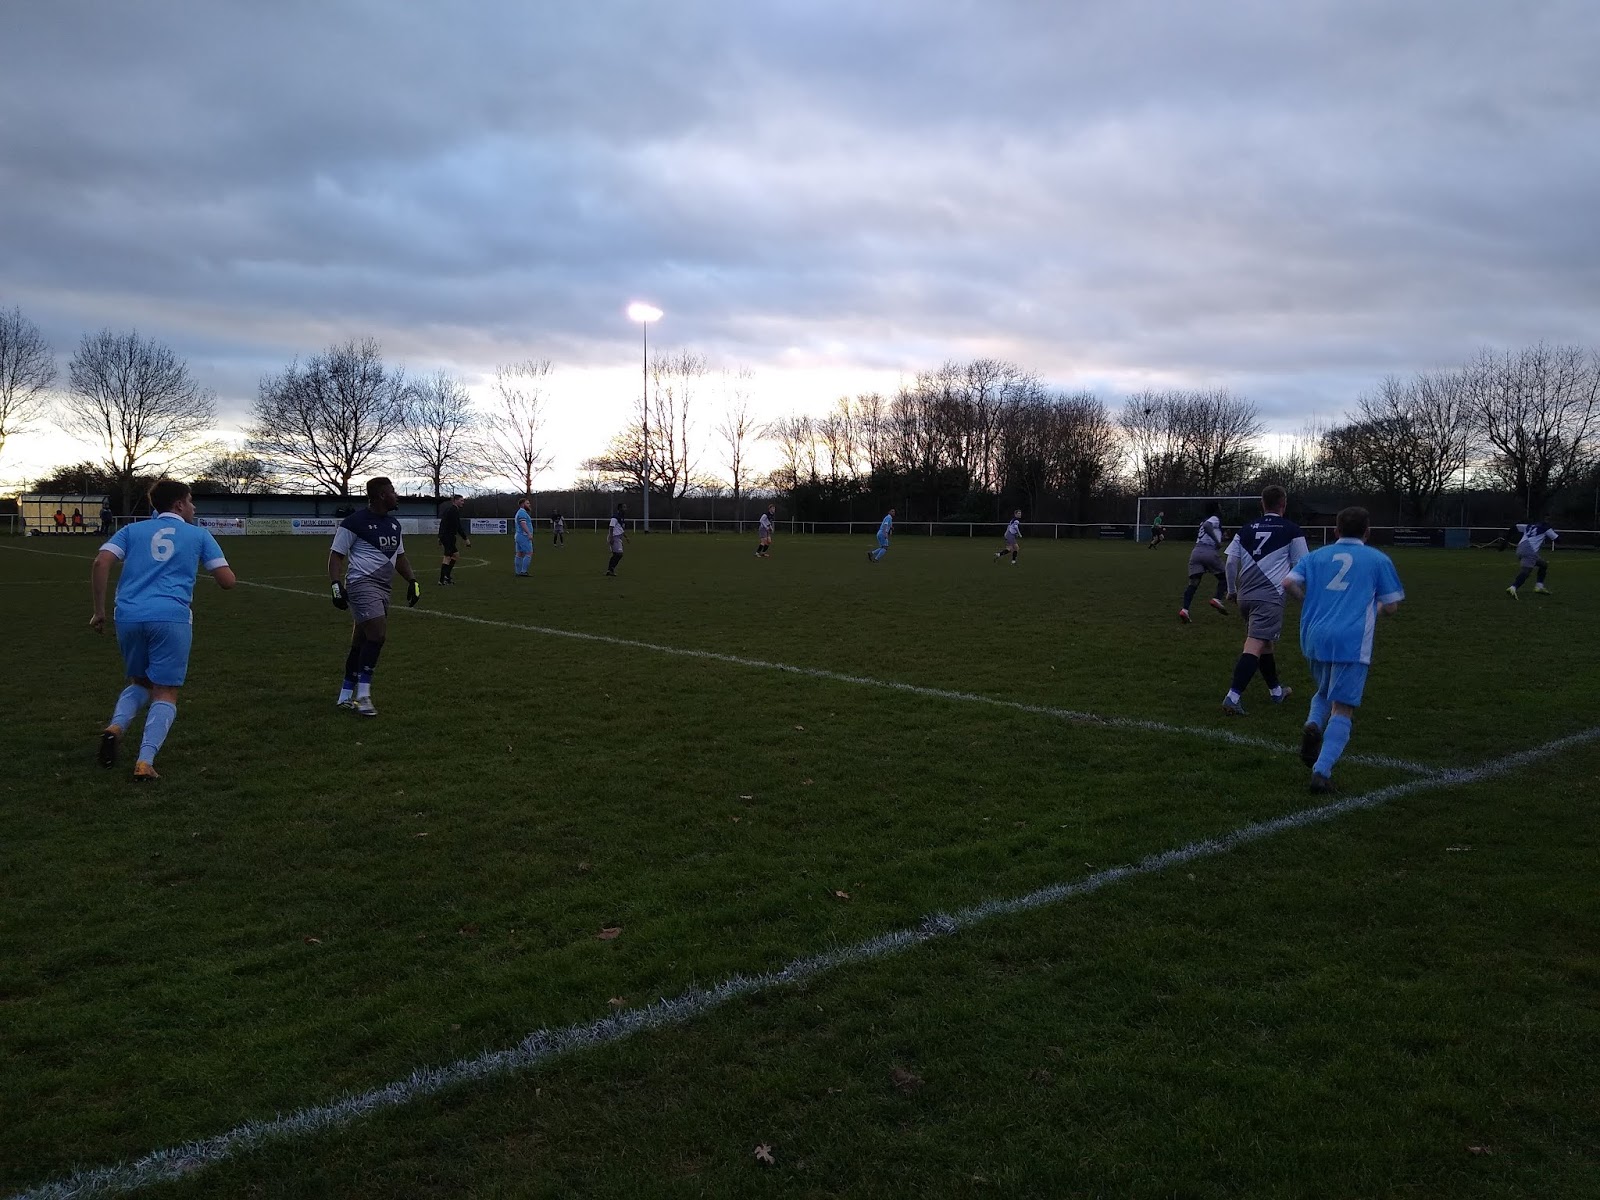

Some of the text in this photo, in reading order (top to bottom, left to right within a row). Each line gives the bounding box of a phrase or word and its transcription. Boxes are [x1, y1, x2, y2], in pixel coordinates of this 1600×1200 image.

[150, 527, 176, 562] 6
[378, 535, 398, 546] DIS
[1252, 531, 1273, 556] 7
[1325, 552, 1353, 591] 2
